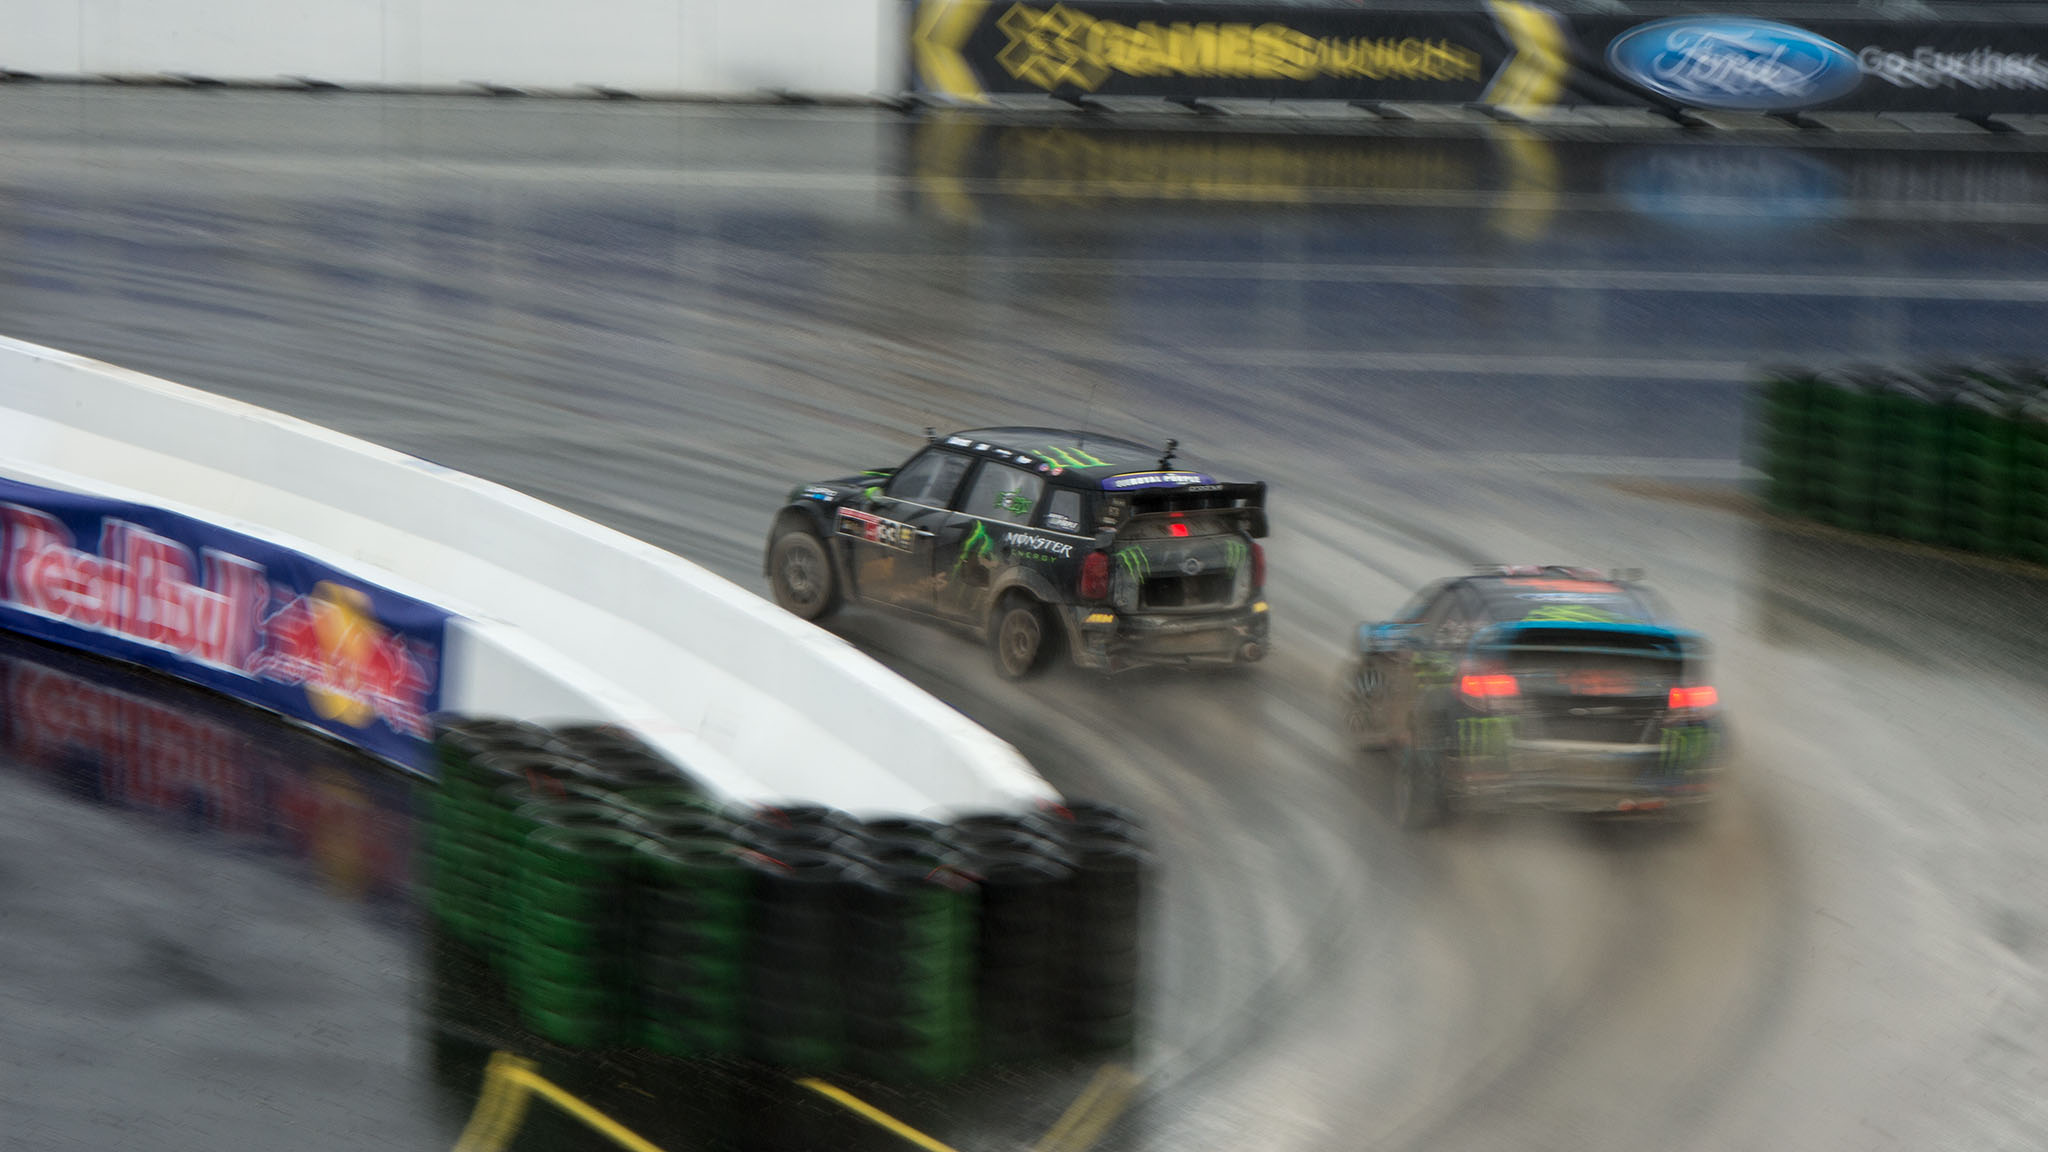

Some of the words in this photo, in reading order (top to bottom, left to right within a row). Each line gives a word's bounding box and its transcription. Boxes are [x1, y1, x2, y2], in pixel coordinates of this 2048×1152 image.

[1304, 34, 1476, 82] MUNICH
[1653, 26, 1815, 97] Ford
[1006, 531, 1073, 559] MONSTER
